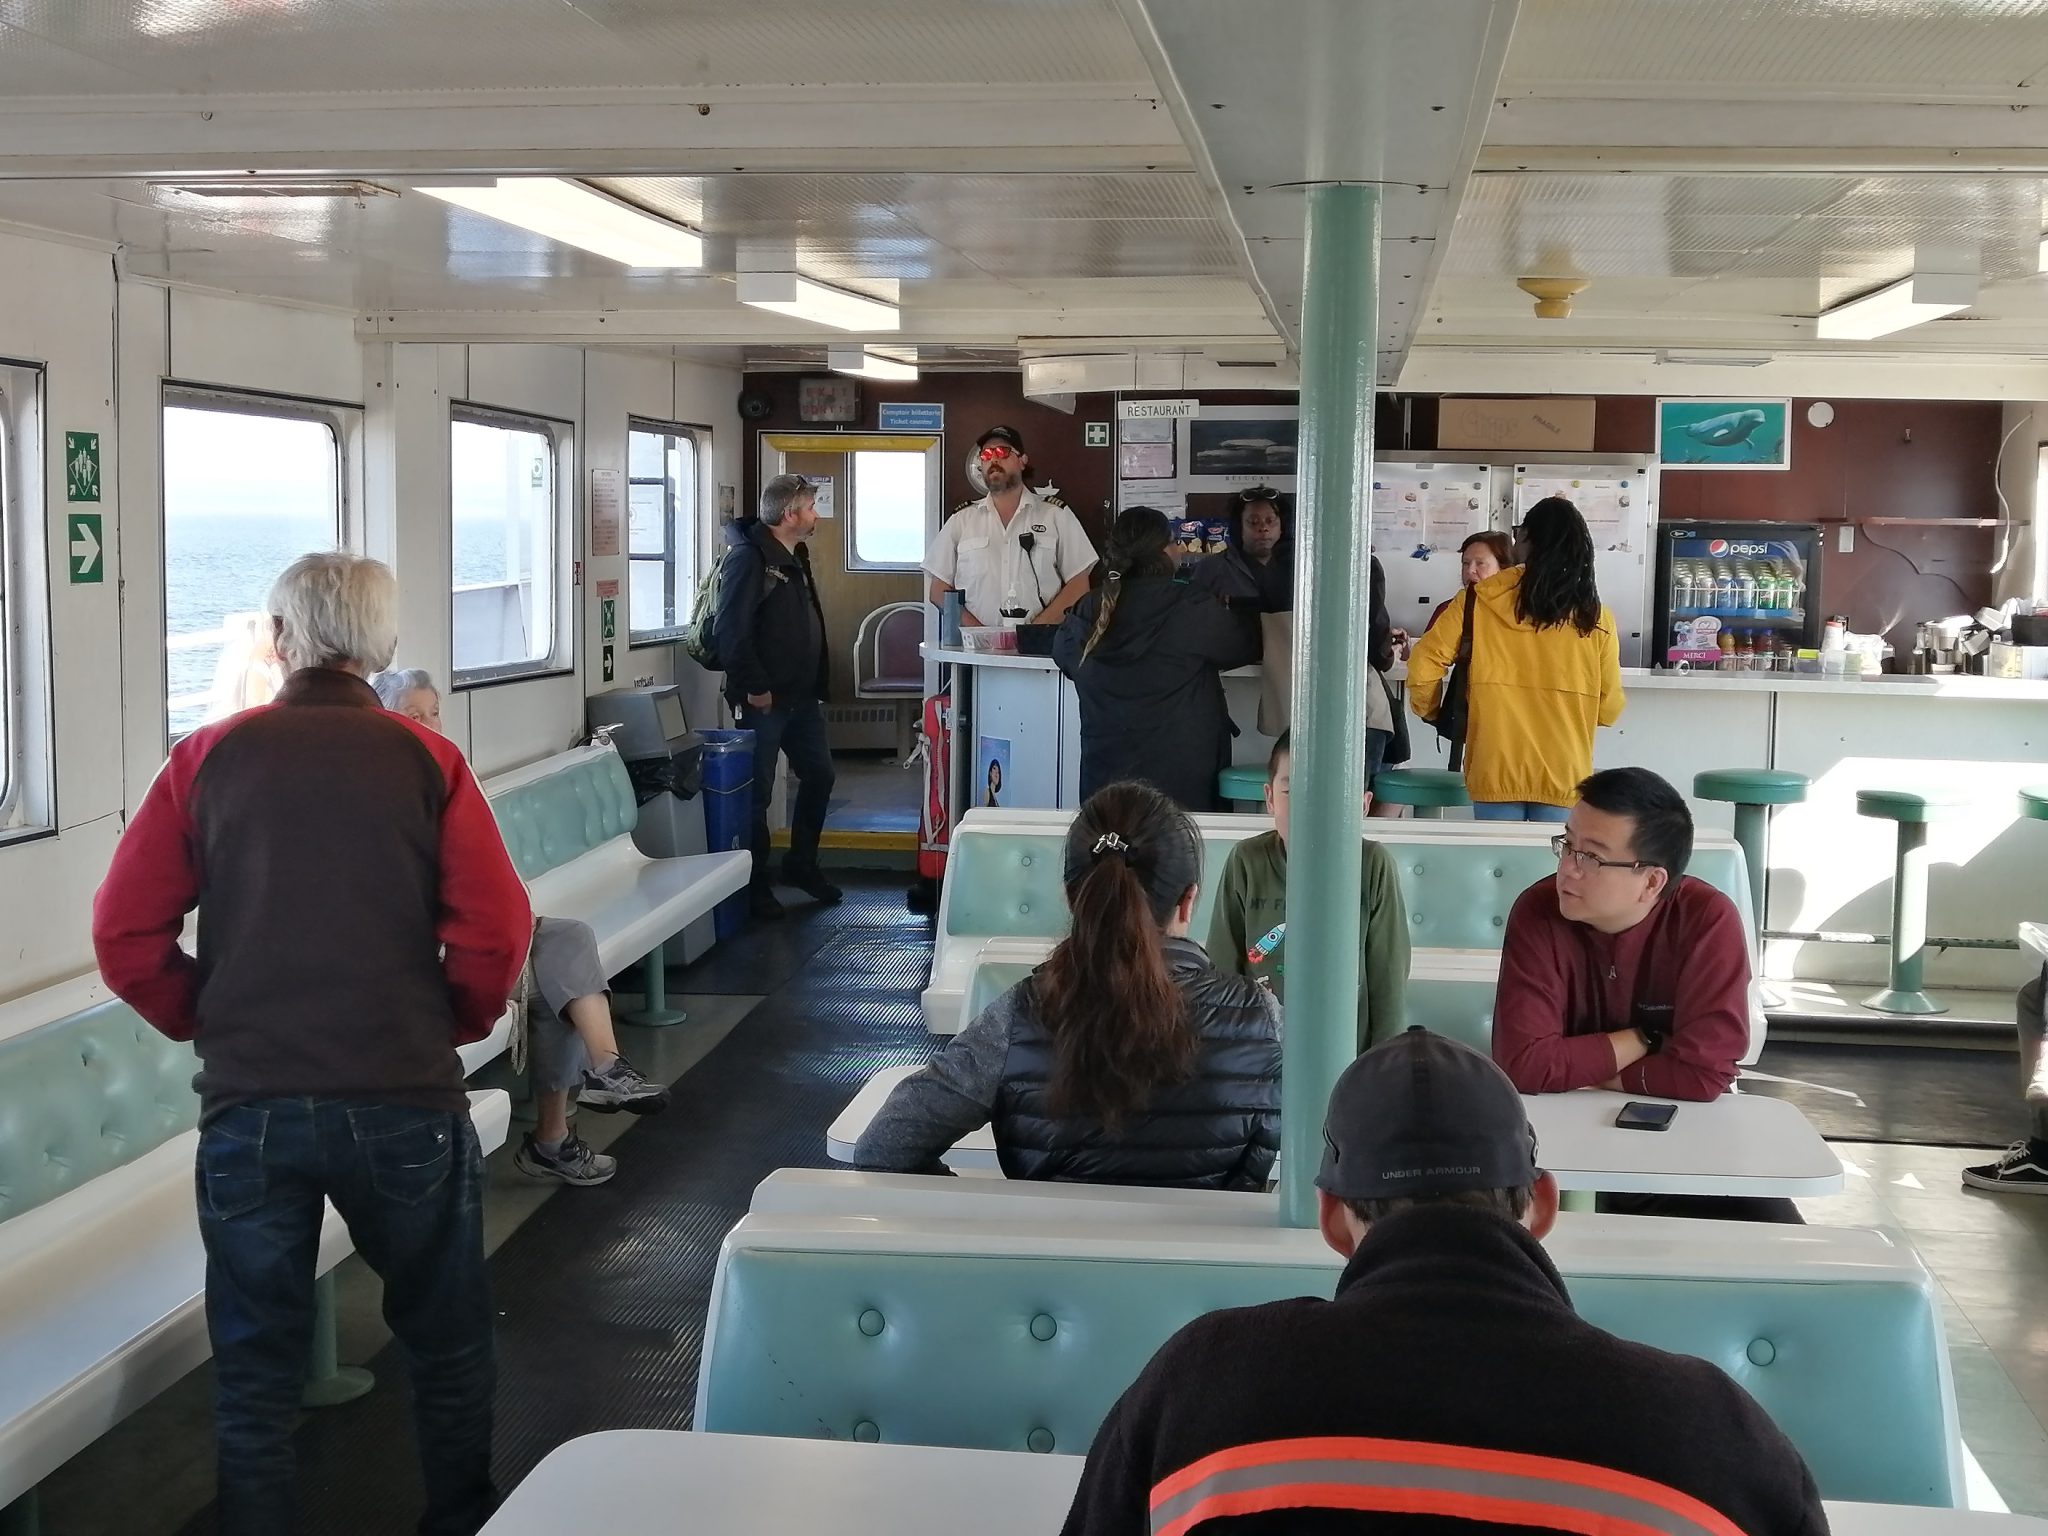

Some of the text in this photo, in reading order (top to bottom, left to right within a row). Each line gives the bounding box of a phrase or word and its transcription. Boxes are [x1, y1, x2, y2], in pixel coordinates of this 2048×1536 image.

[1127, 404, 1191, 417] RESTAURANT
[1532, 413, 1561, 434] FRAGILE
[1730, 541, 1768, 556] pepsi
[1682, 651, 1706, 659] MERCI
[1382, 1166, 1481, 1180] UNDER ARMOUR
